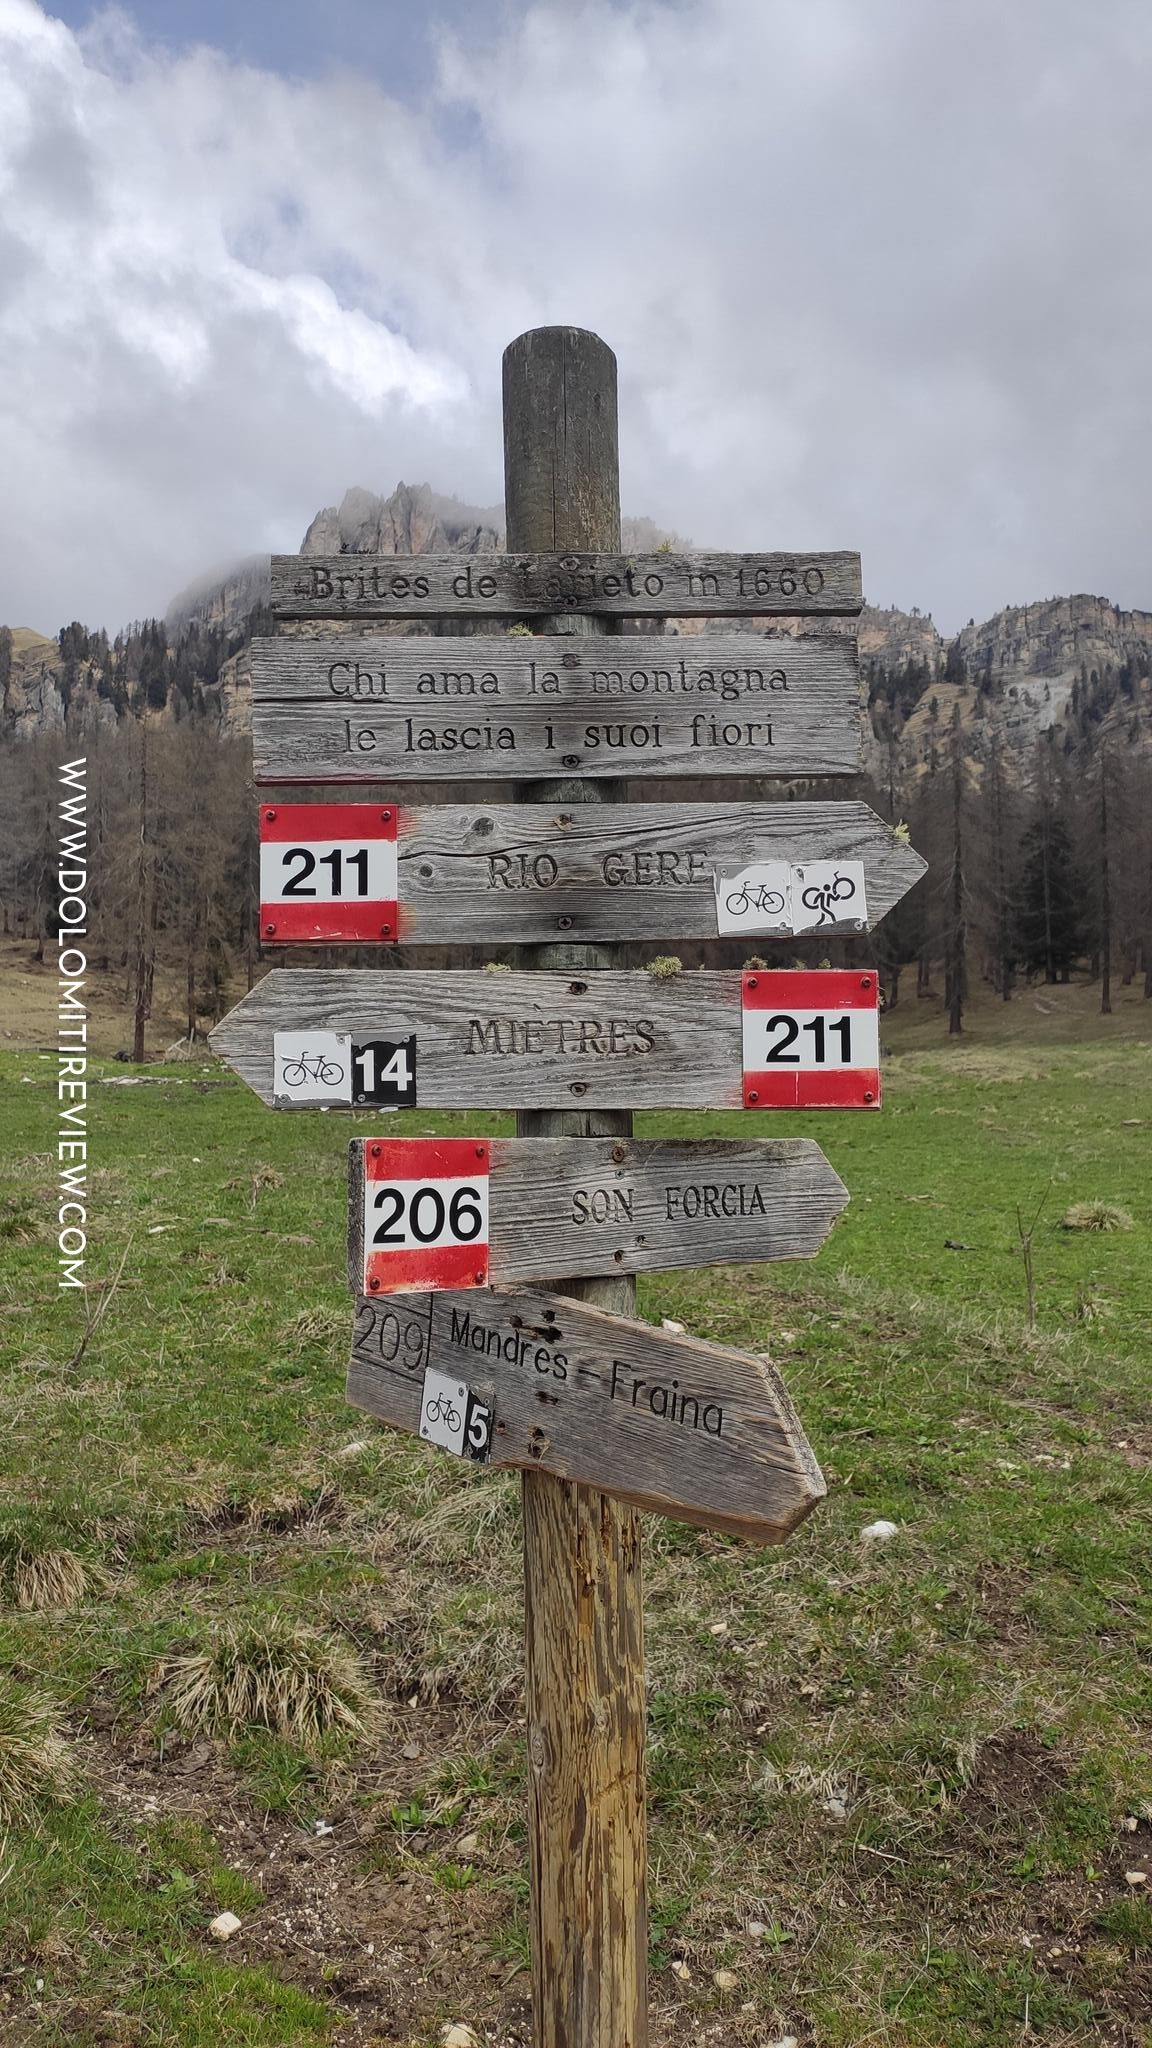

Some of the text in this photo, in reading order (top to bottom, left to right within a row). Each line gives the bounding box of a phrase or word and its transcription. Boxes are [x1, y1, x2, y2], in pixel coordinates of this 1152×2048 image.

[312, 566, 430, 600] Brites
[451, 567, 498, 600] de
[734, 568, 826, 599] 1660
[328, 661, 790, 700] Chi ama la montagna
[345, 714, 776, 752] le lascia i suoi fiori
[281, 847, 370, 896] 211
[487, 850, 708, 890] RIO GERE
[463, 1018, 658, 1057] MIETRES
[765, 1014, 852, 1064] 211
[356, 1049, 413, 1093] 14
[372, 1186, 483, 1245] 206
[571, 1184, 768, 1225] SON FORCIA
[355, 1304, 426, 1372] 209
[450, 1307, 569, 1381] Mandres
[610, 1360, 724, 1438] Fraina
[467, 1405, 490, 1449] 5
